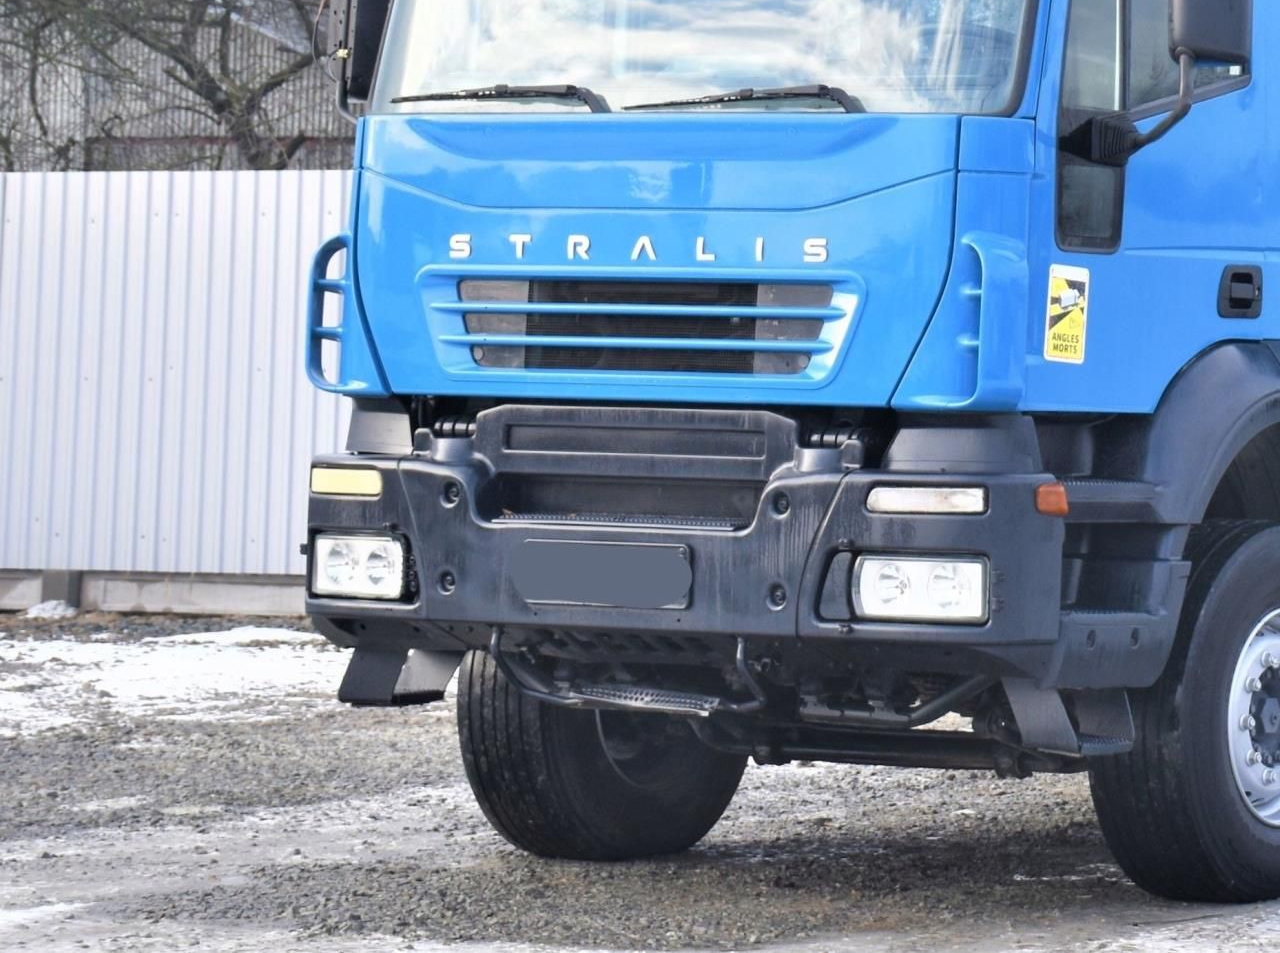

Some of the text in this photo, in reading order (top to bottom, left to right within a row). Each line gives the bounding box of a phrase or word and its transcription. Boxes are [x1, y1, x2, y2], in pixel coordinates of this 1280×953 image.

[449, 233, 830, 262] STRALIS
[1052, 333, 1080, 344] ANGLES
[1053, 343, 1078, 355] MORTS
